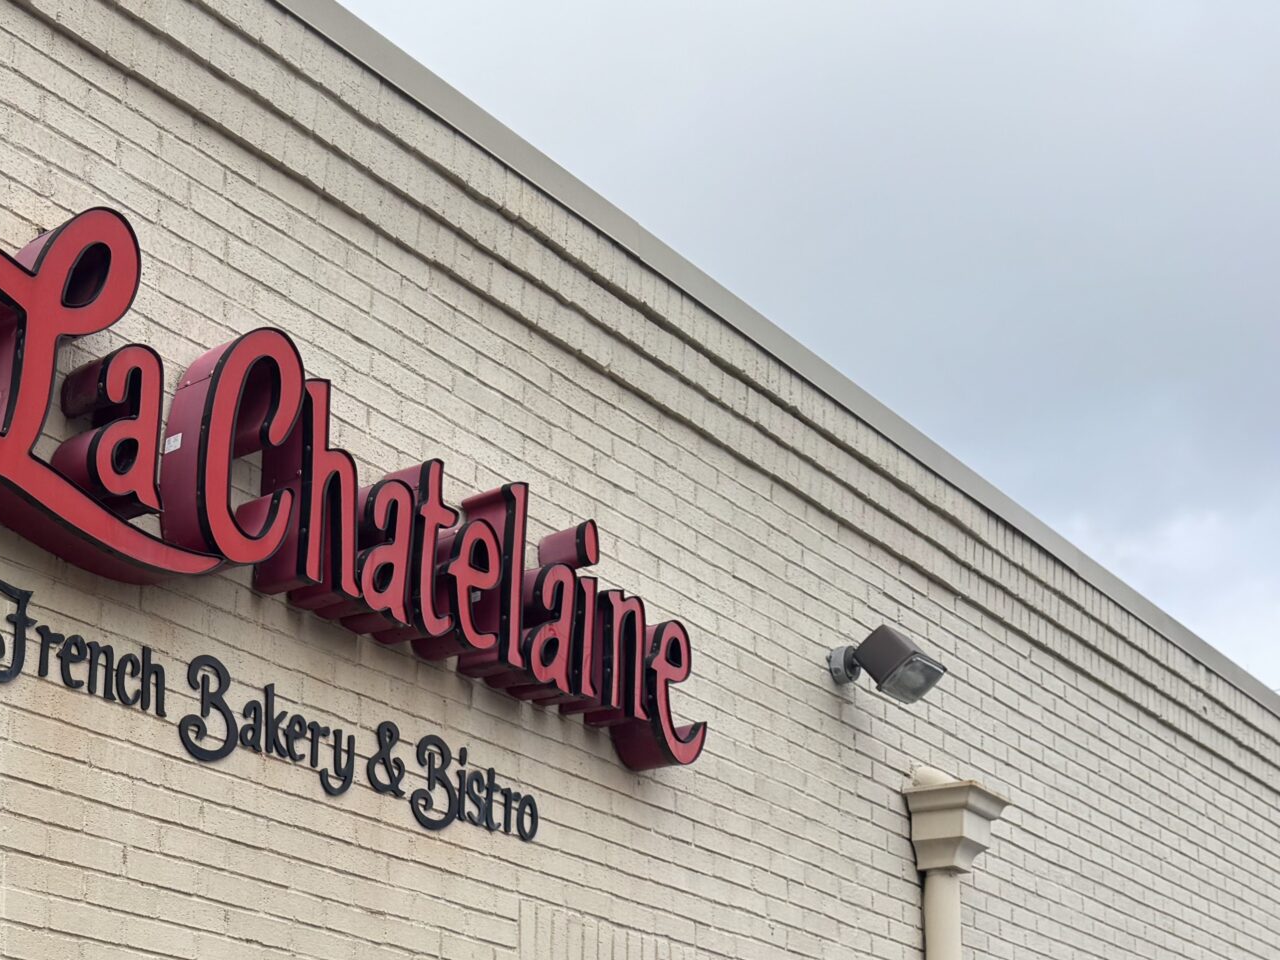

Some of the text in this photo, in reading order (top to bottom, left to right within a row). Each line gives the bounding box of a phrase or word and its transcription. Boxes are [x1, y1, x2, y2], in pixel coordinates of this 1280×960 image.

[182, 325, 708, 769] Chatelaine
[178, 654, 357, 796] Bakery
[367, 721, 406, 799] &
[411, 734, 539, 843] Bistro
